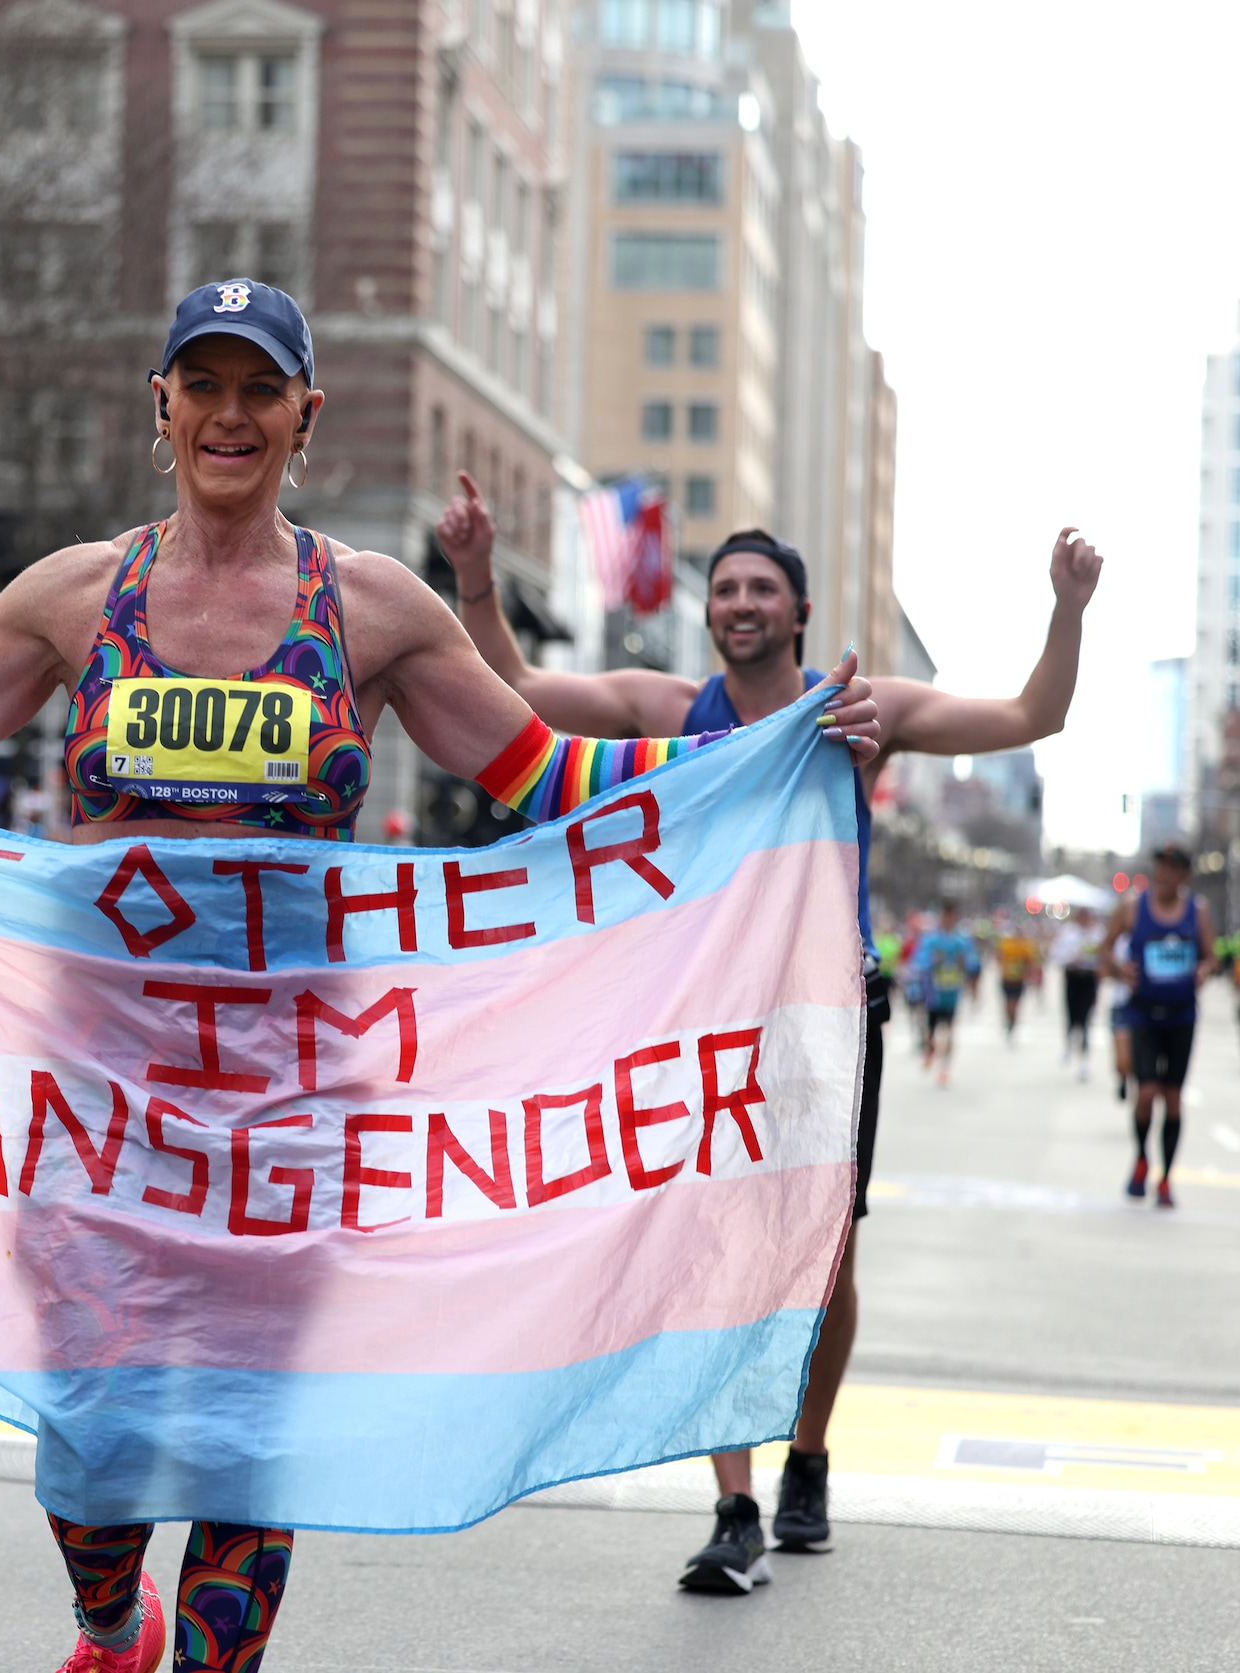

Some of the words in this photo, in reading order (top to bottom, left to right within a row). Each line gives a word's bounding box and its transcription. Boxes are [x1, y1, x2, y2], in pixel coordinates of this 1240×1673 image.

[213, 283, 251, 313] B
[126, 687, 293, 754] 30078
[114, 757, 127, 772] 7
[182, 787, 238, 800] BOSTON
[94, 790, 675, 971] OTHER
